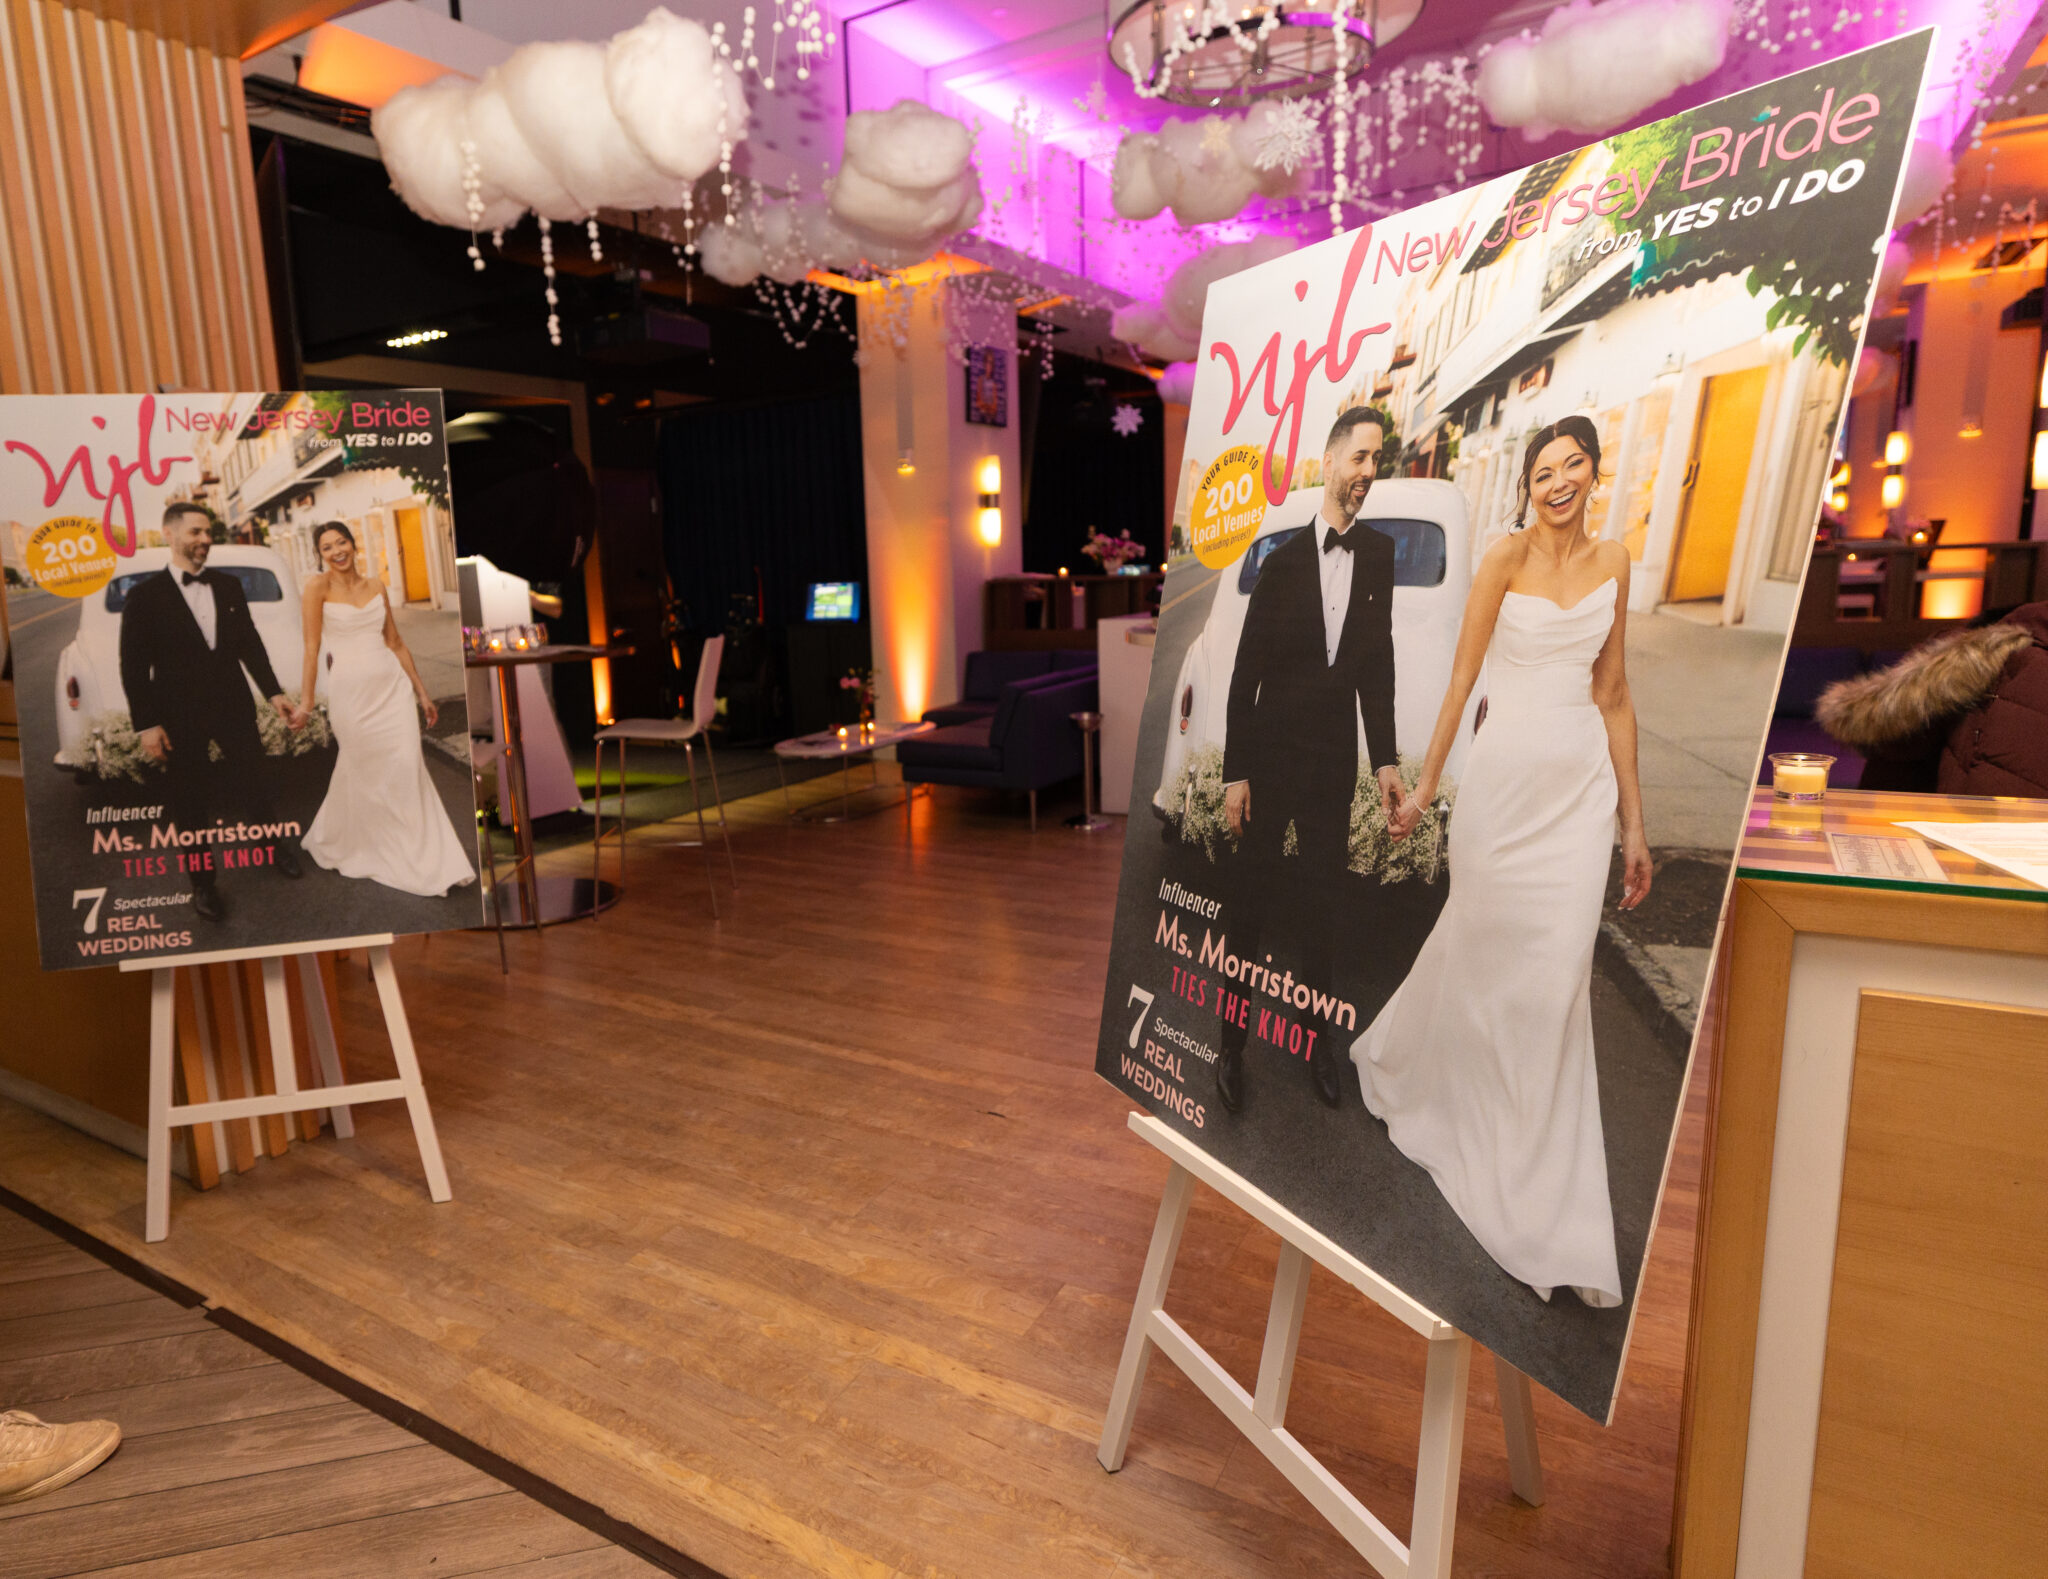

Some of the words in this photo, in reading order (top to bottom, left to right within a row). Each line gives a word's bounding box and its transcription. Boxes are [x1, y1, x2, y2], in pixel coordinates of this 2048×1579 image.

[1373, 220, 1477, 284] New
[1482, 157, 1668, 249] Jersey
[1679, 87, 1880, 192] Bride
[1576, 228, 1642, 262] from
[1650, 197, 1724, 241] YES
[1728, 196, 1763, 221] to
[1767, 177, 1790, 211] I
[1790, 158, 1866, 206] DO
[1210, 223, 1391, 507] njb
[165, 405, 237, 432] New
[245, 405, 344, 434] Jersey
[351, 401, 431, 428] Bride
[309, 438, 343, 449] from
[345, 433, 378, 447] YES
[381, 435, 396, 446] to
[397, 433, 405, 446] I
[406, 432, 433, 445] DO
[5, 394, 193, 557] njb
[1201, 463, 1221, 491] YOUR
[1223, 450, 1249, 466] GUIDE
[1249, 455, 1259, 470] TO
[1204, 473, 1253, 519] 200
[1193, 518, 1220, 546] Local
[1223, 505, 1263, 534] Venues
[34, 563, 69, 583] Local
[69, 556, 115, 575] Venues
[41, 534, 97, 564] 200
[86, 805, 164, 824] Influencer
[92, 827, 143, 854] Ms.
[150, 819, 301, 849] Morristown
[123, 857, 167, 878] TIES
[176, 851, 214, 873] THE
[223, 846, 276, 869] KNOT
[72, 887, 107, 934] 7
[113, 892, 193, 911] Spectacular
[1159, 878, 1222, 920] Influencer
[77, 931, 193, 957] WEDDINGS
[107, 914, 162, 934] REAL
[1155, 909, 1193, 958] Ms.
[1199, 928, 1356, 1031] Morristown
[1127, 984, 1155, 1049] 7
[1172, 966, 1207, 1007] TIES
[1215, 987, 1250, 1030] THE
[1257, 1008, 1317, 1062] KNOT
[1144, 1039, 1185, 1083] REAL
[1154, 1017, 1219, 1065] Spectacular
[1121, 1053, 1205, 1128] WEDDINGS
